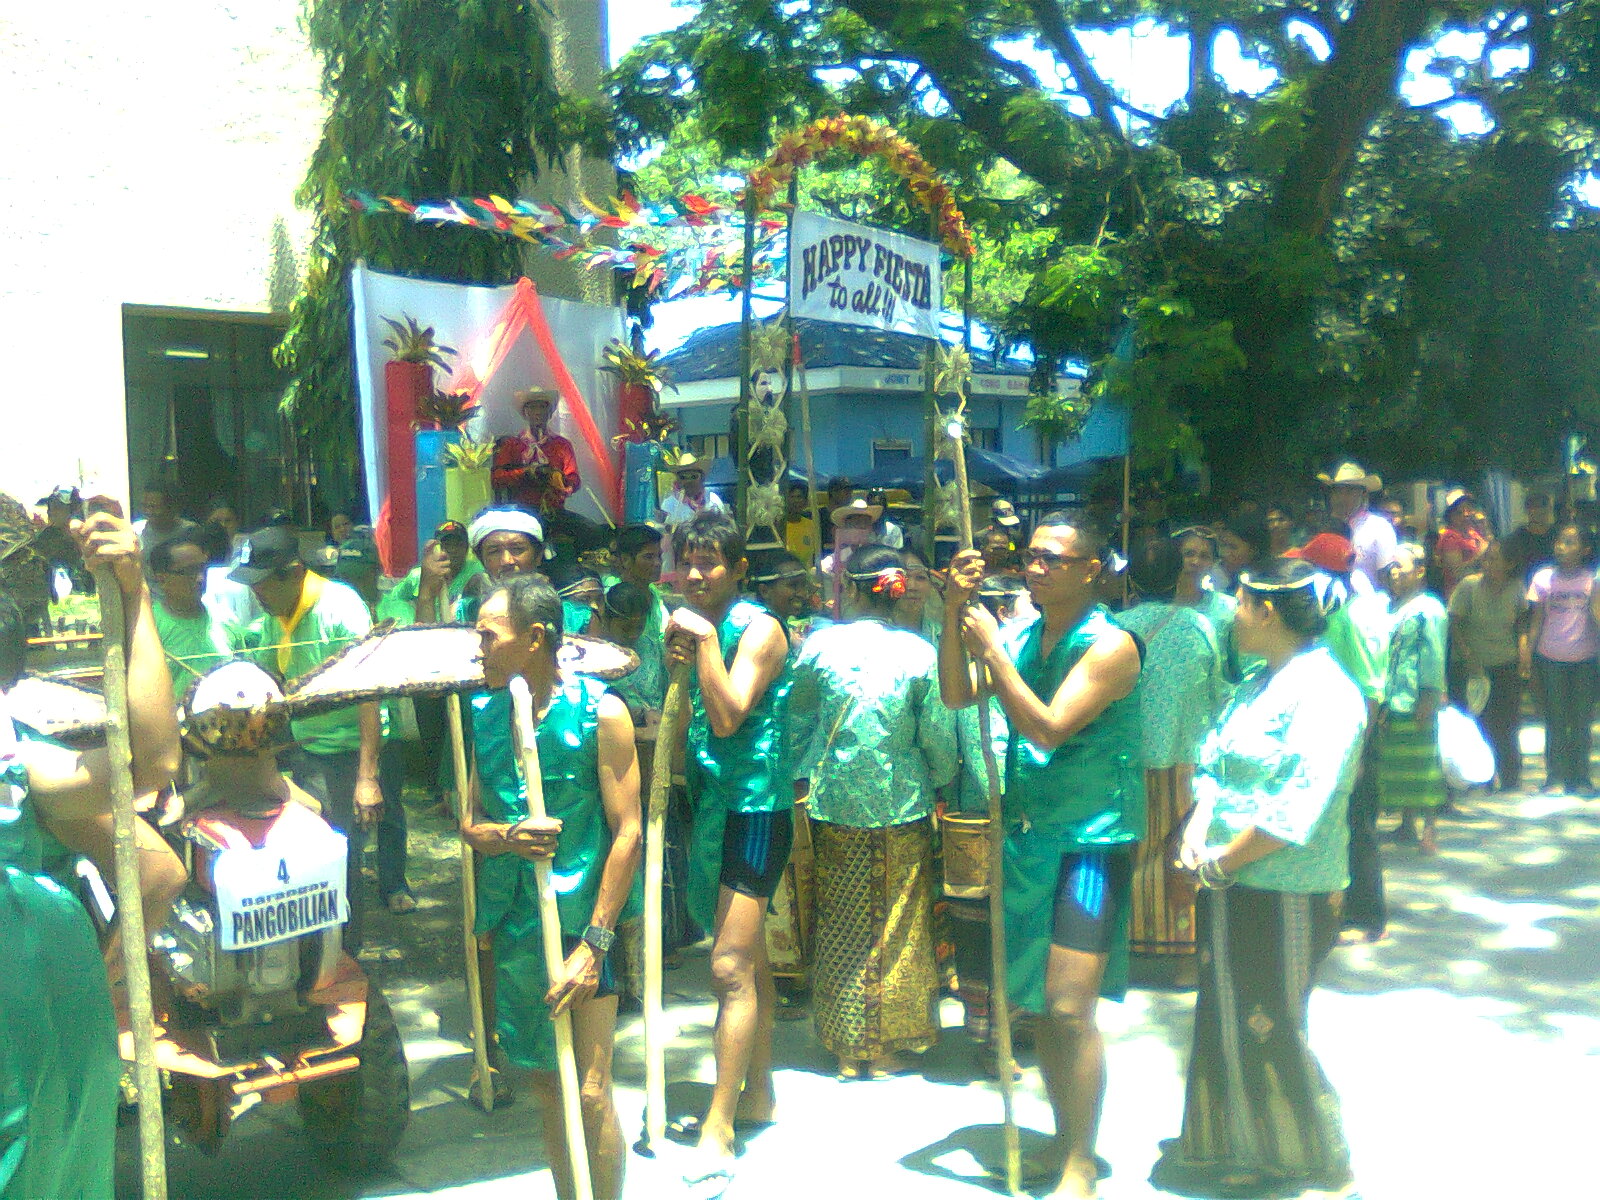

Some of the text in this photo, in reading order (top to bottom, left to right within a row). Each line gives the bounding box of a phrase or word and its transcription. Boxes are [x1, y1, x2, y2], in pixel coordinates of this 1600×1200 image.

[803, 235, 931, 310] HAPPY FIESTA
[277, 858, 290, 884] 4
[232, 889, 338, 945] PANGOBILIAN
